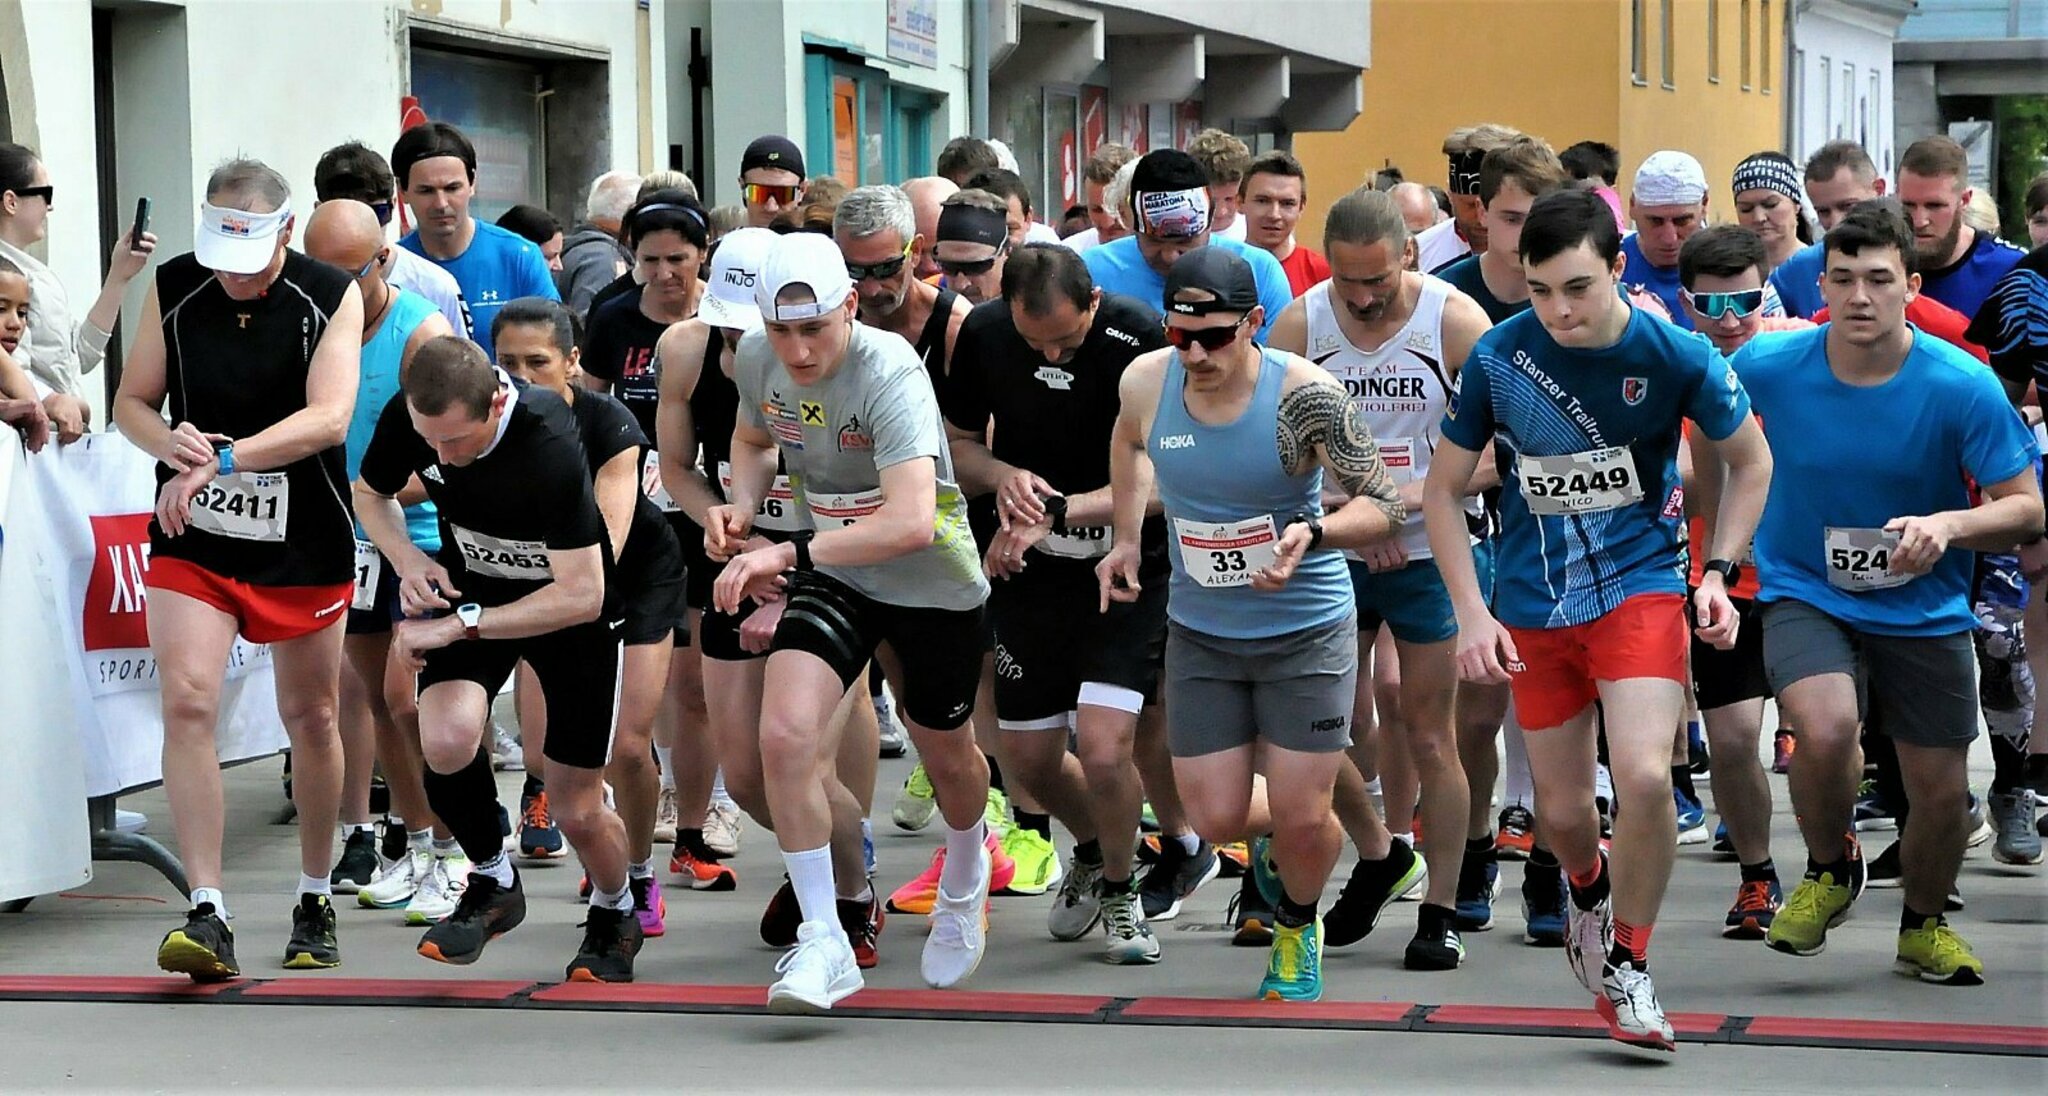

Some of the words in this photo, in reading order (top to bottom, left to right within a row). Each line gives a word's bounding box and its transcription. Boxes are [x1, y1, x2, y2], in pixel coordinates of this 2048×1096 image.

[1144, 195, 1186, 210] MARATONA
[1105, 327, 1134, 345] CRAFT
[1344, 364, 1398, 376] TEAM
[1512, 349, 1567, 401] Stanzer
[1341, 377, 1428, 400] DINGER
[1357, 402, 1427, 412] HOLFREI
[1160, 433, 1196, 450] HOKA
[1526, 466, 1630, 497] 52449
[1562, 497, 1594, 508] NICO
[462, 541, 551, 569] 52453
[1210, 550, 1247, 573] 33
[1832, 548, 1889, 572] 524
[1311, 715, 1345, 733] HOKA
